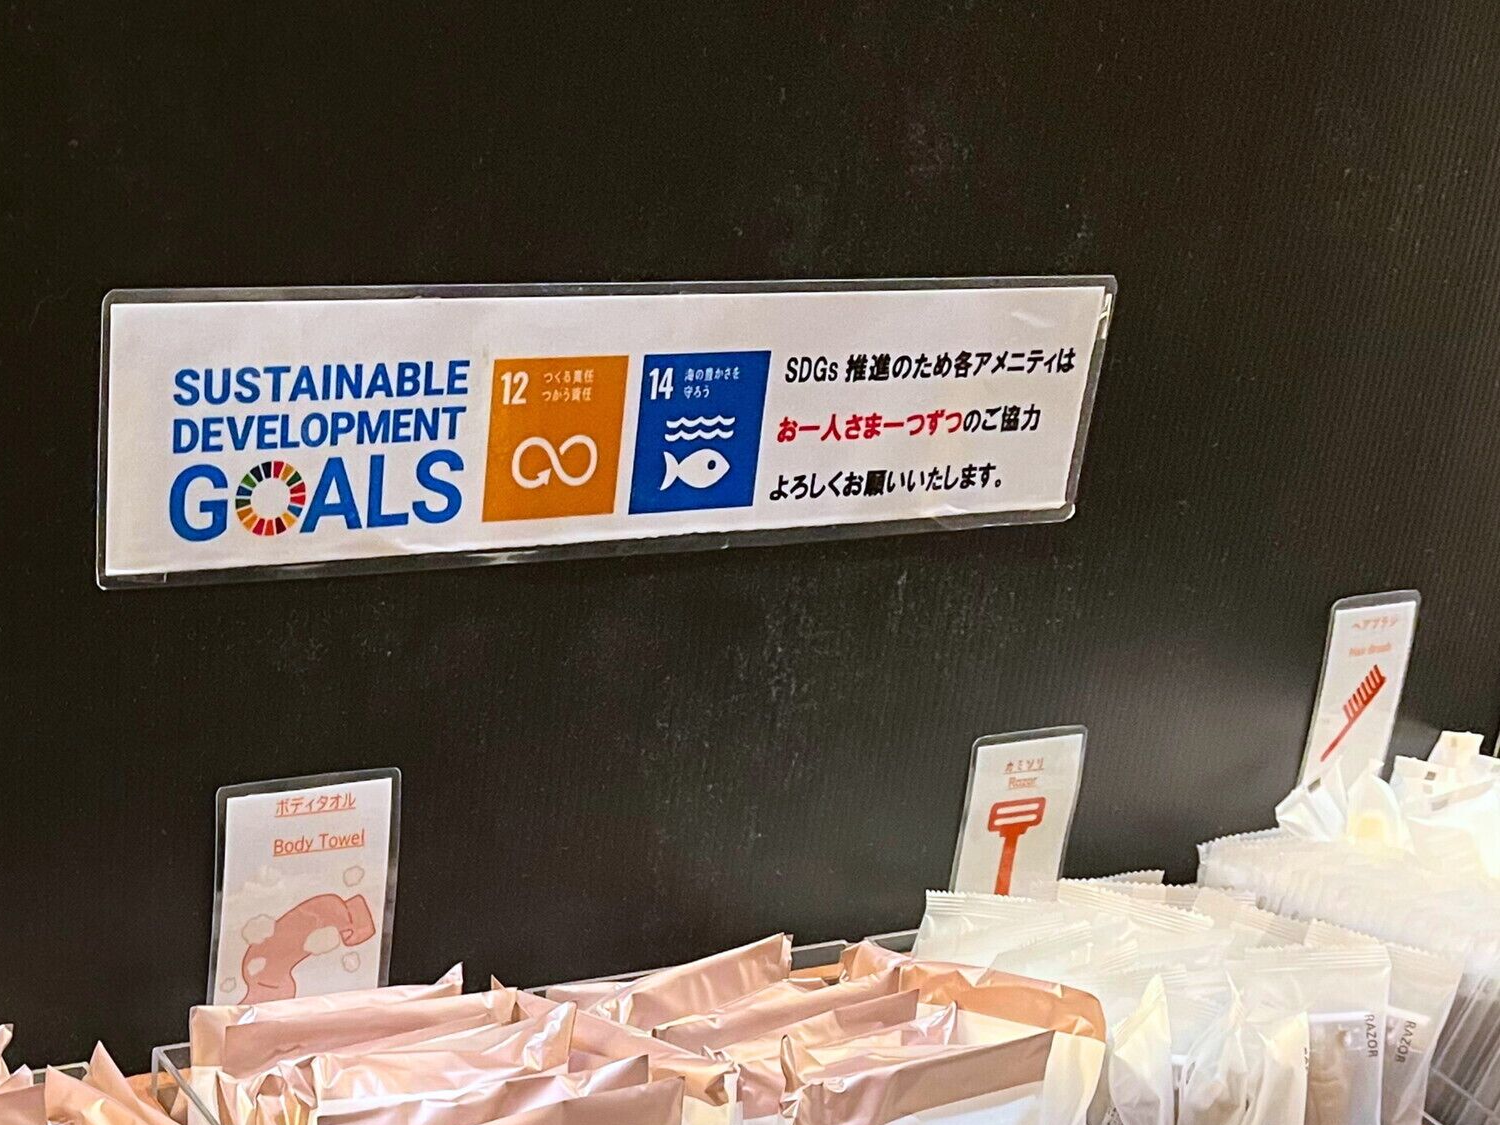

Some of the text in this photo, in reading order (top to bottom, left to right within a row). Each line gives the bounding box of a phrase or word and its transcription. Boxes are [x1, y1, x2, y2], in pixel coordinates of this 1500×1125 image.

[544, 369, 594, 384] つくる責任
[684, 367, 741, 382] 海の豊かさを
[785, 347, 1076, 383] SDGs 推進のため各アメニティは
[173, 360, 470, 406] SUSTAINABLE
[500, 371, 529, 405] 12
[542, 386, 592, 402] つかう責任
[649, 368, 674, 400] 14
[683, 385, 710, 400] 守ろう
[172, 406, 467, 454] DEVELOPMENT
[776, 404, 1041, 443] お一人さま一つずつのご協力
[169, 449, 464, 543] GOALS
[770, 463, 1002, 500] よろしくお願いいたします。
[275, 793, 356, 816] ボディタオル
[273, 829, 365, 856] Body Towel
[1365, 1014, 1378, 1058] RAZOR
[1396, 1020, 1417, 1063] RAZOR
